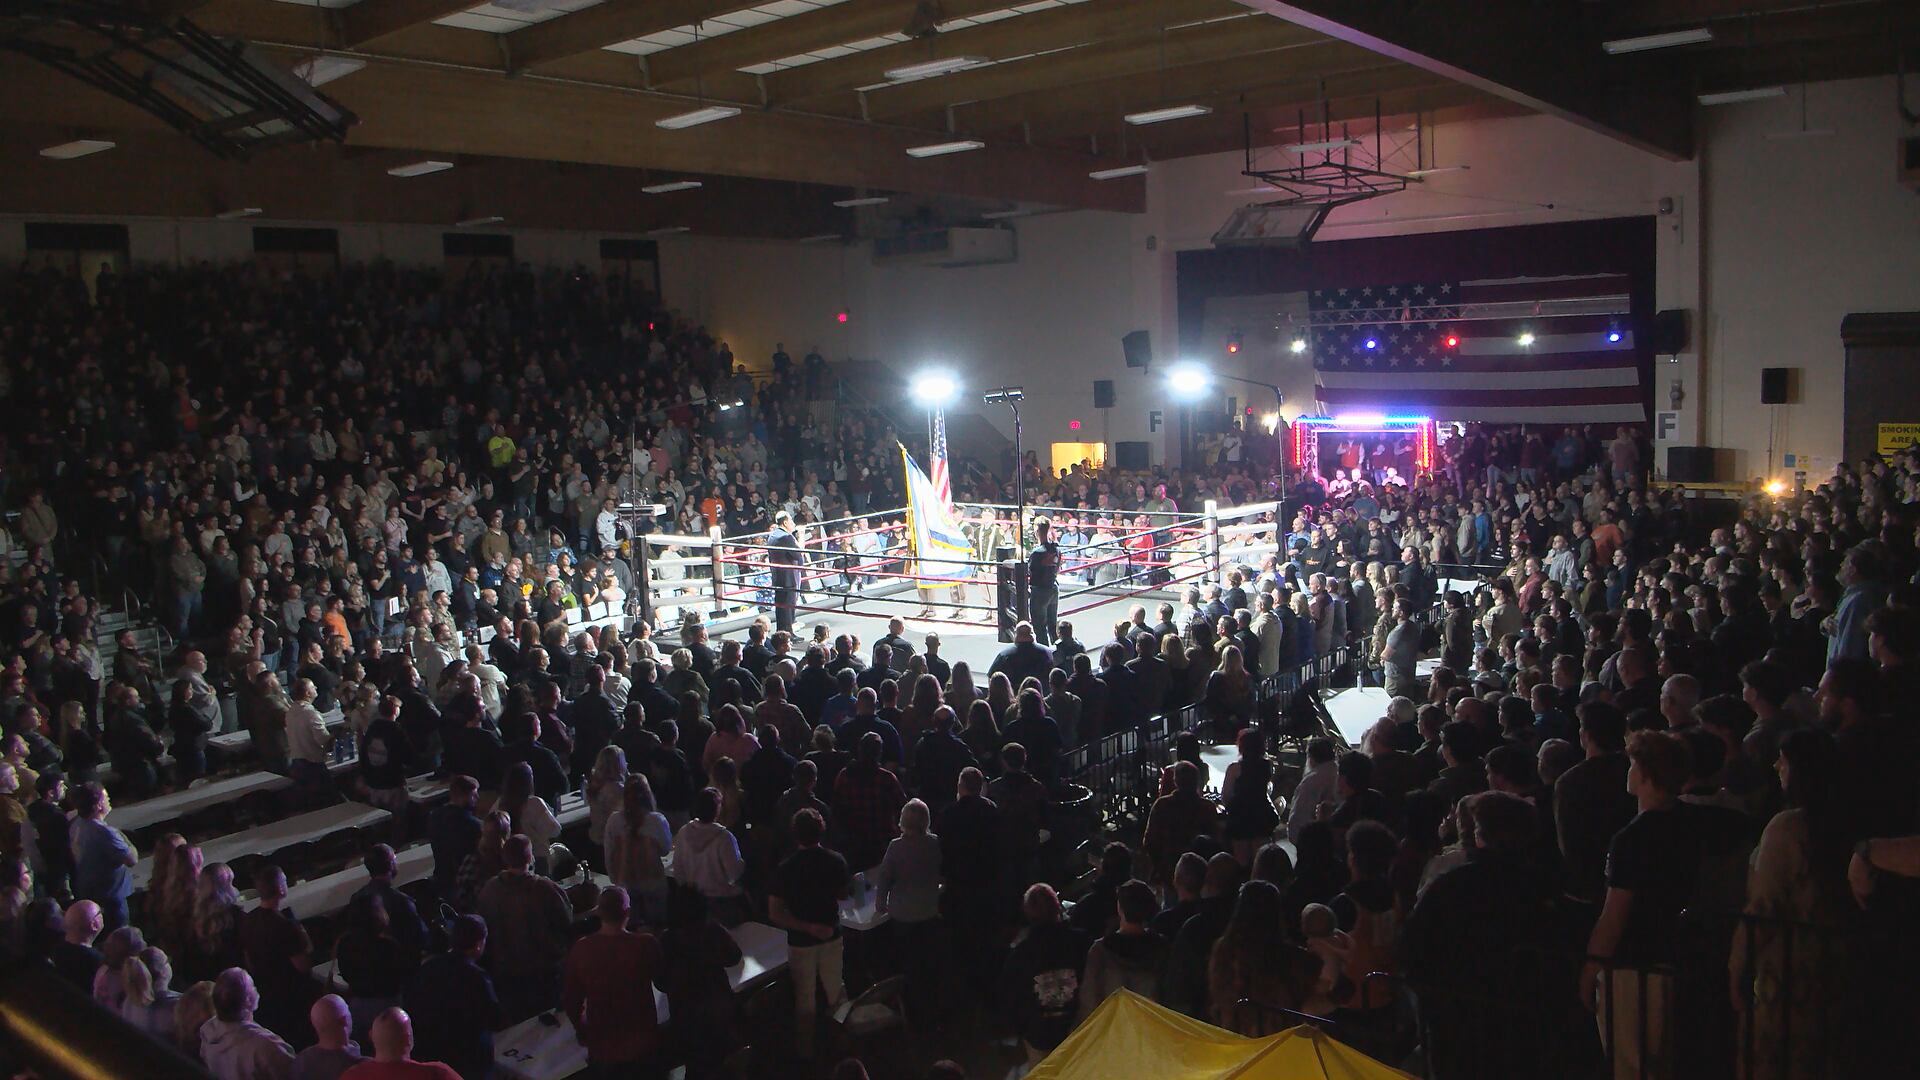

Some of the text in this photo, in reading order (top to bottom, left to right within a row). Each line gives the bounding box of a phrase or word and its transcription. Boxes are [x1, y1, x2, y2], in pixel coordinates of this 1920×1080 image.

[1150, 411, 1161, 432] F
[1658, 413, 1675, 439] F
[1890, 436, 1917, 444] AREA
